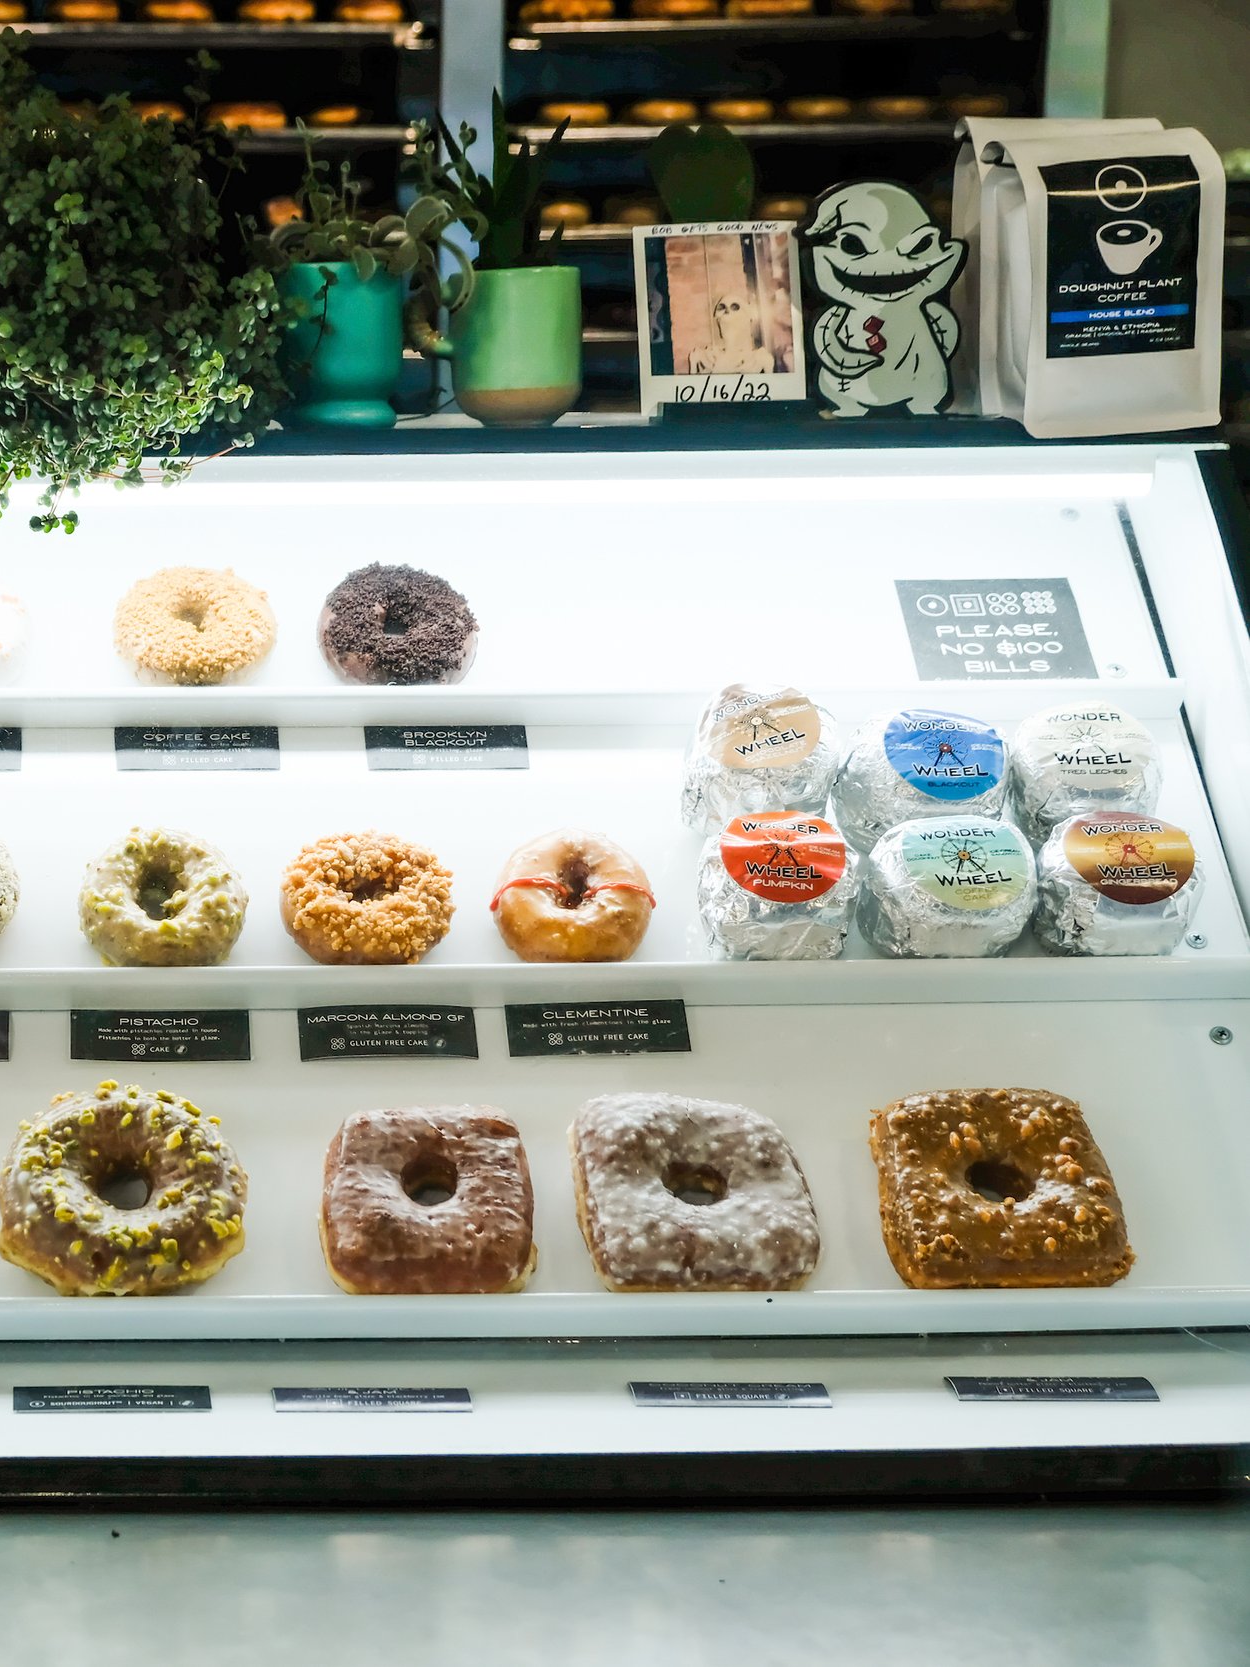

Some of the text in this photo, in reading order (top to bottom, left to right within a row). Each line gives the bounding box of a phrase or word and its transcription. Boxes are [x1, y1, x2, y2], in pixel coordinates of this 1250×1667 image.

[717, 223, 743, 231] GOOD
[1059, 278, 1182, 293] DOUGHNUT PLANT
[1098, 292, 1147, 303] COFFEE
[1089, 309, 1155, 319] HOUSE BLEND
[1122, 322, 1160, 330] ETHIOPIA
[941, 639, 1063, 657] NO $100
[964, 660, 1050, 673] BILLS
[1046, 713, 1122, 723] WONDER
[903, 721, 978, 731] WONDE
[143, 733, 203, 741] COFFEE
[735, 729, 805, 755] WHEEL
[1055, 753, 1132, 765] WHEEL
[913, 764, 989, 777] WHEEL
[920, 828, 996, 841] WONDER
[1082, 824, 1163, 836] WONDER
[746, 861, 822, 879] WHEEL
[1098, 862, 1176, 877] WHEEL
[935, 871, 1012, 886] WHEEL
[753, 879, 813, 890] PUMPKIN
[955, 887, 998, 895] COFFEE
[308, 1014, 378, 1024] MARCONA
[543, 1009, 648, 1019] CLEMENTINE
[120, 1018, 198, 1026] PISTACHIO
